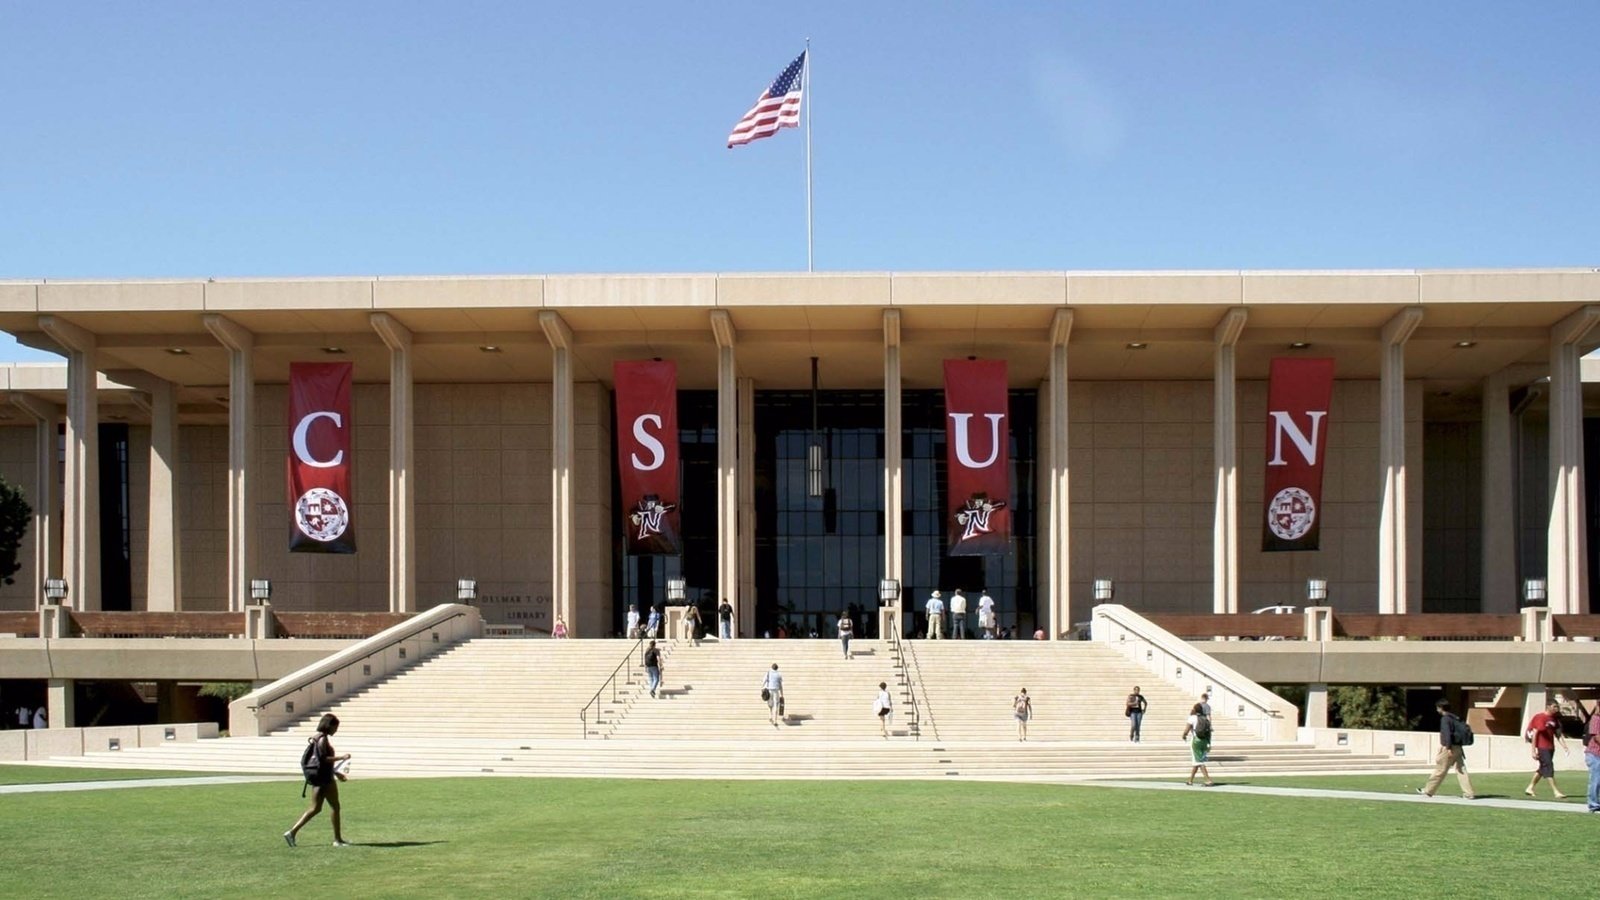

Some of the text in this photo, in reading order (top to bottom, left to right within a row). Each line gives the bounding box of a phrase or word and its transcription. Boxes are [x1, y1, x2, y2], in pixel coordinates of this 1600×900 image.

[293, 411, 343, 468] C
[632, 414, 665, 471] S
[948, 412, 1005, 468] U
[1268, 411, 1327, 466] N
[638, 510, 667, 540] N
[962, 509, 994, 540] N
[507, 611, 546, 619] LIBRARY
